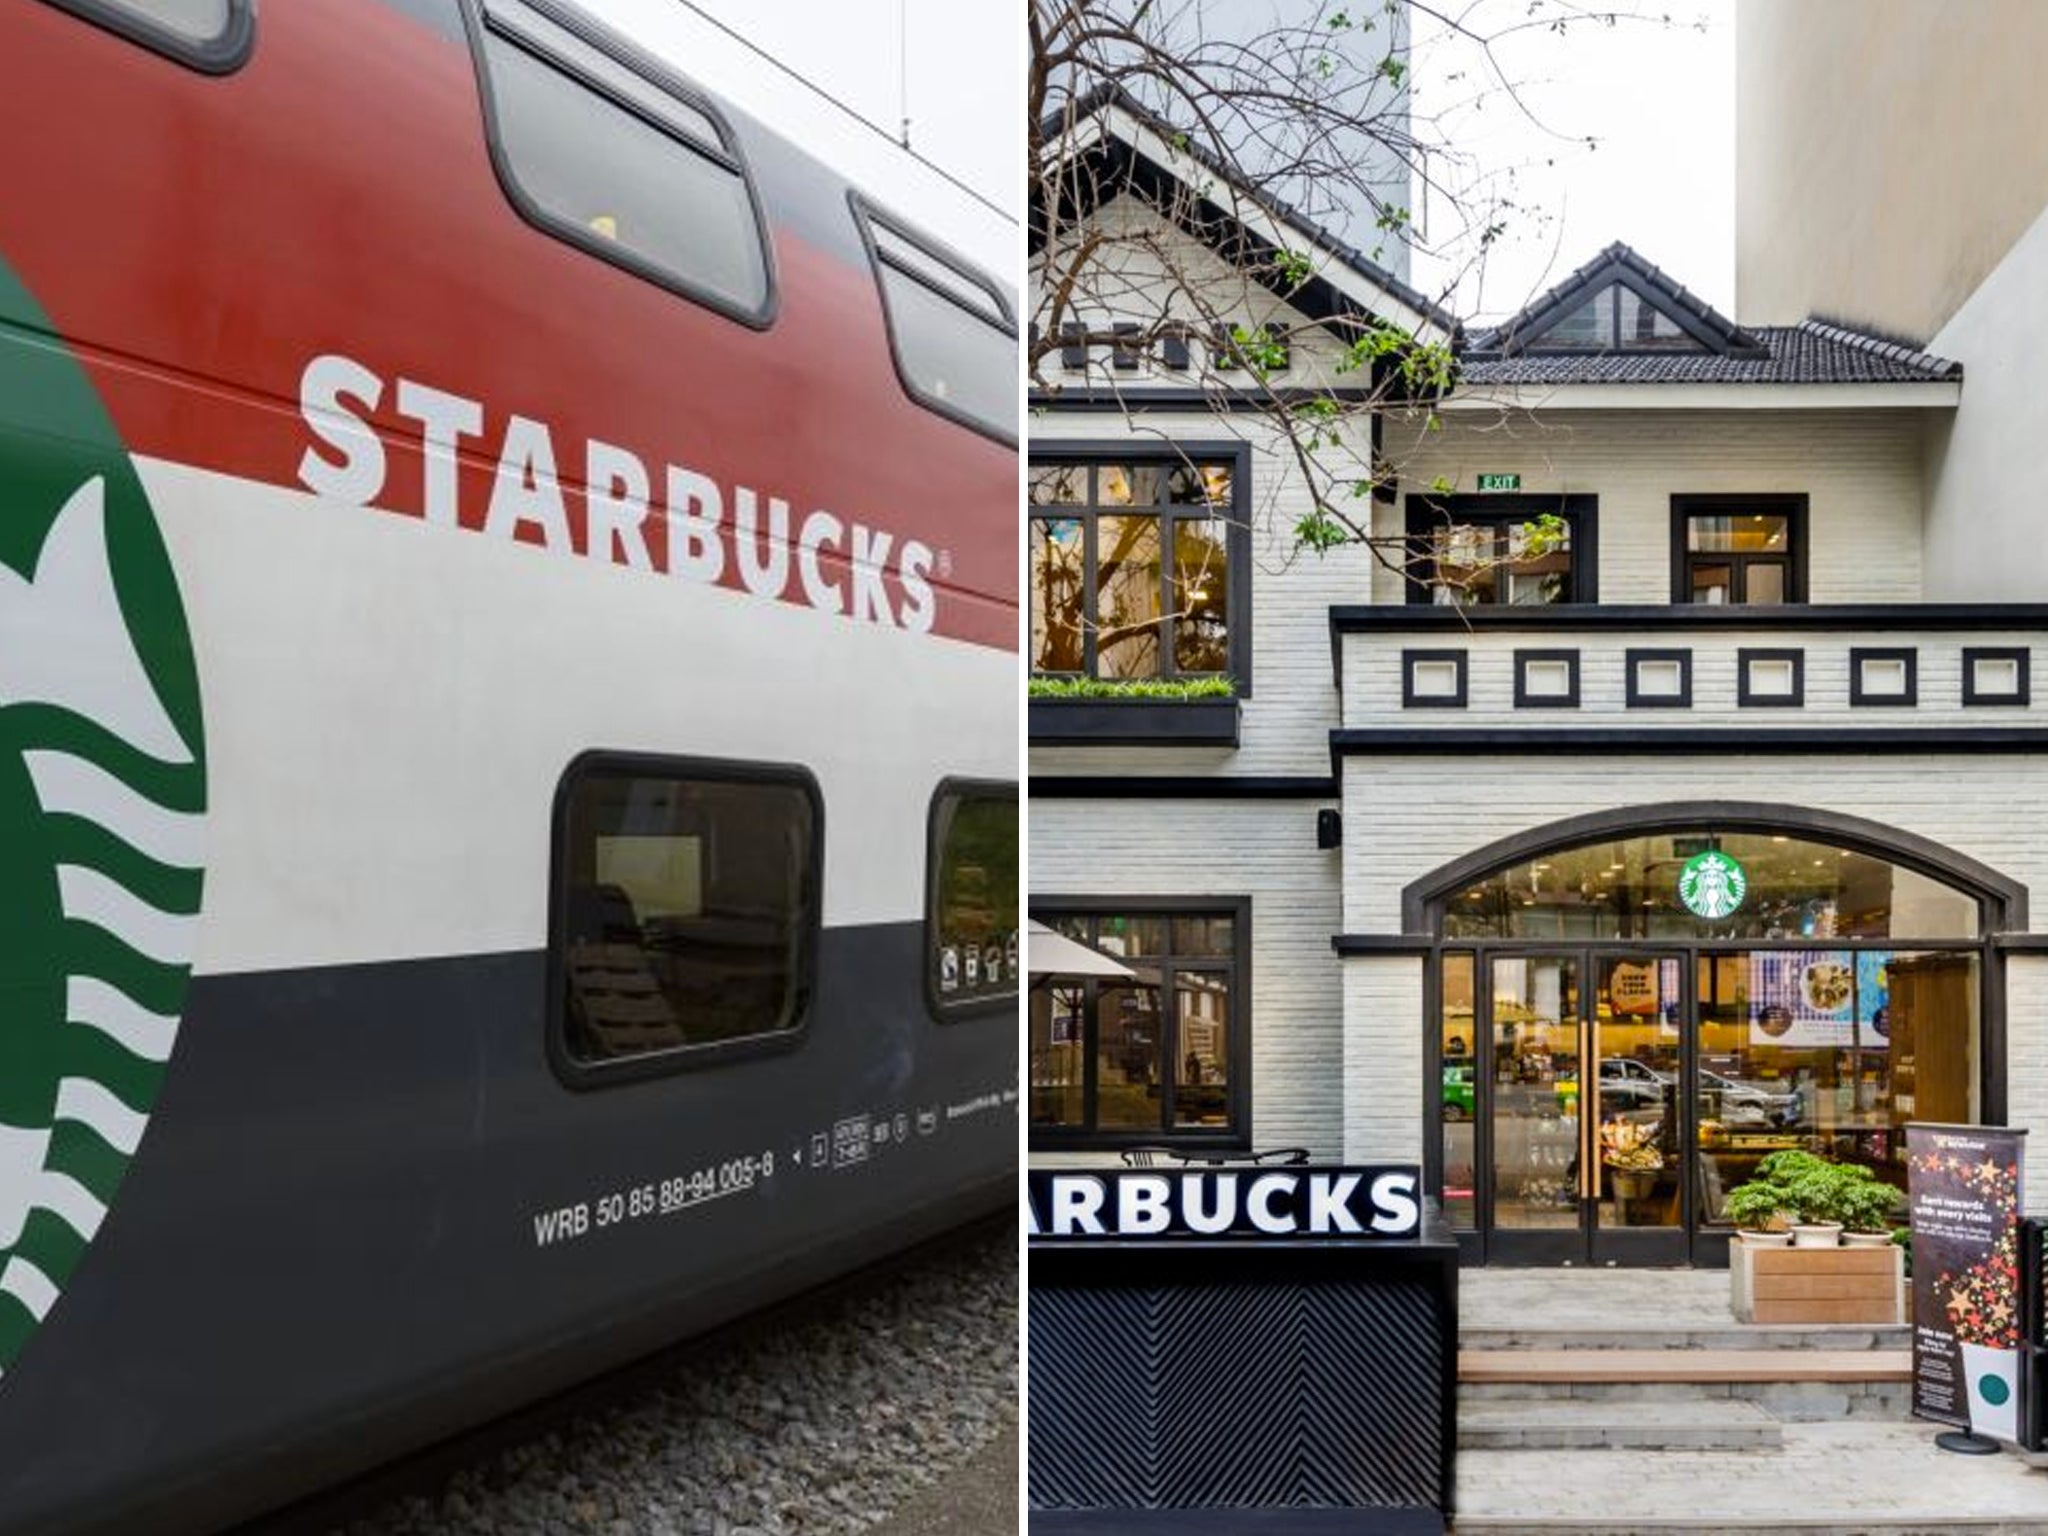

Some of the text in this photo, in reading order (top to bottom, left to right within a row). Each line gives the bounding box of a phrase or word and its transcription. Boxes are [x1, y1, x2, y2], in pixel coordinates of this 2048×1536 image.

[1483, 475, 1516, 489] EXIT
[297, 354, 939, 635] STARBUCKS
[1943, 1198, 1984, 1210] rewards
[534, 1202, 589, 1246] WRB
[596, 1193, 624, 1226] 50
[629, 1184, 655, 1218] 85
[1936, 1209, 1963, 1221] every
